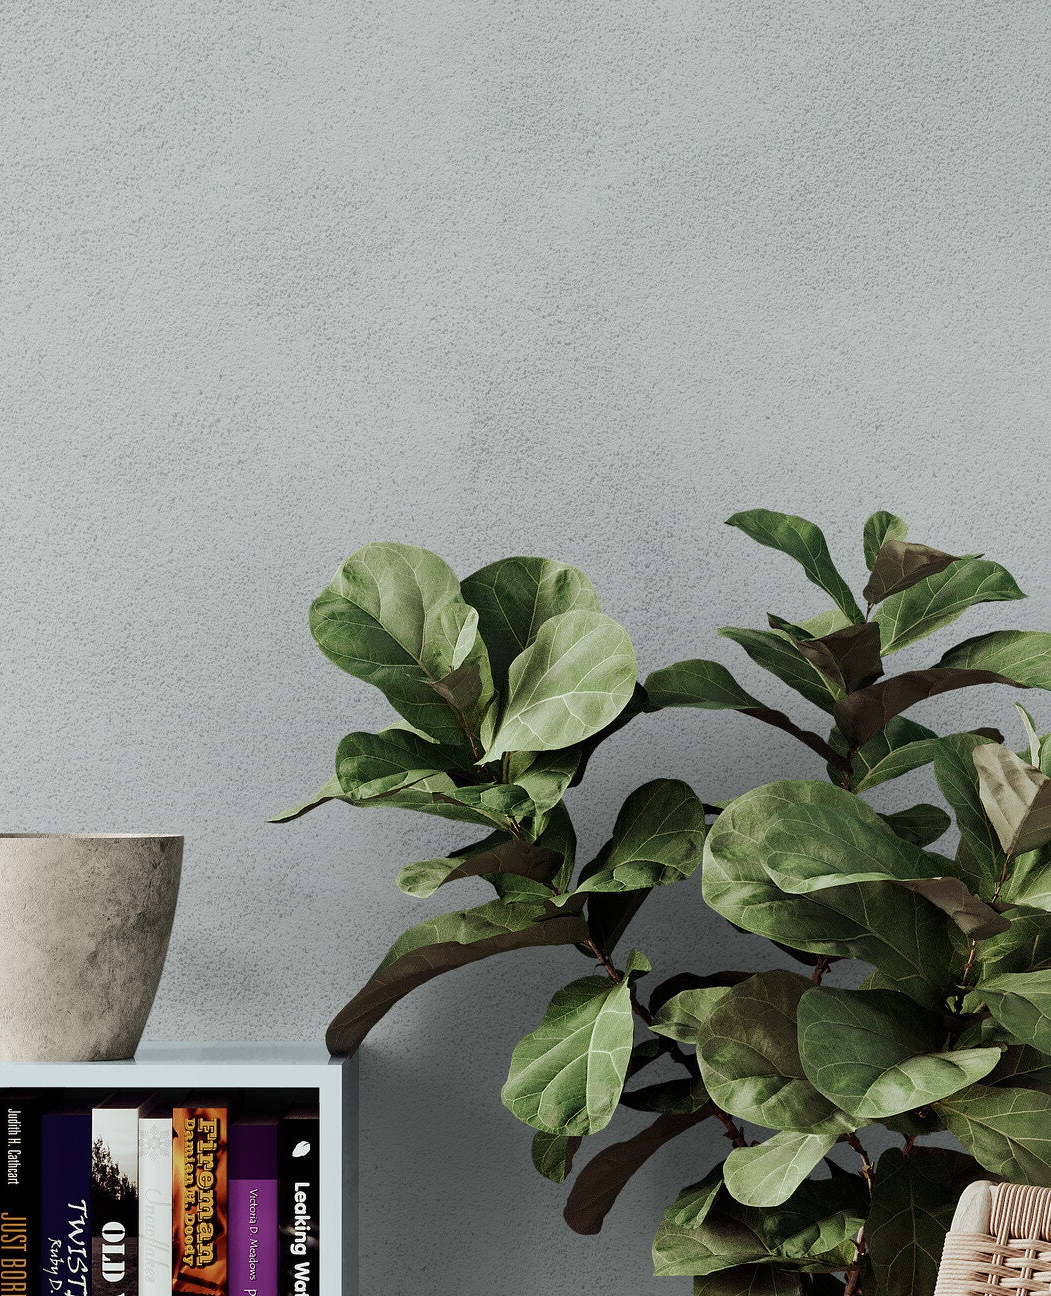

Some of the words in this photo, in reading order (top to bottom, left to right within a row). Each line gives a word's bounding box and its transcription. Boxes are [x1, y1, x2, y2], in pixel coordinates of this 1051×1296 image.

[8, 1107, 22, 1136] Judith
[8, 1138, 20, 1147] H.
[185, 1118, 196, 1186] Damian
[8, 1149, 20, 1185] Cathcart
[185, 1190, 195, 1208] H.
[197, 1118, 218, 1266] Fireman
[249, 1189, 258, 1223] Victoria
[0, 1212, 27, 1252] JUST
[249, 1227, 258, 1236] D.
[290, 1182, 310, 1255] Leaking
[43, 1237, 62, 1276] Ruby
[101, 1221, 126, 1282] OLD
[183, 1214, 195, 1266] Doody
[249, 1239, 258, 1280] Meadows
[48, 1278, 62, 1293] D.
